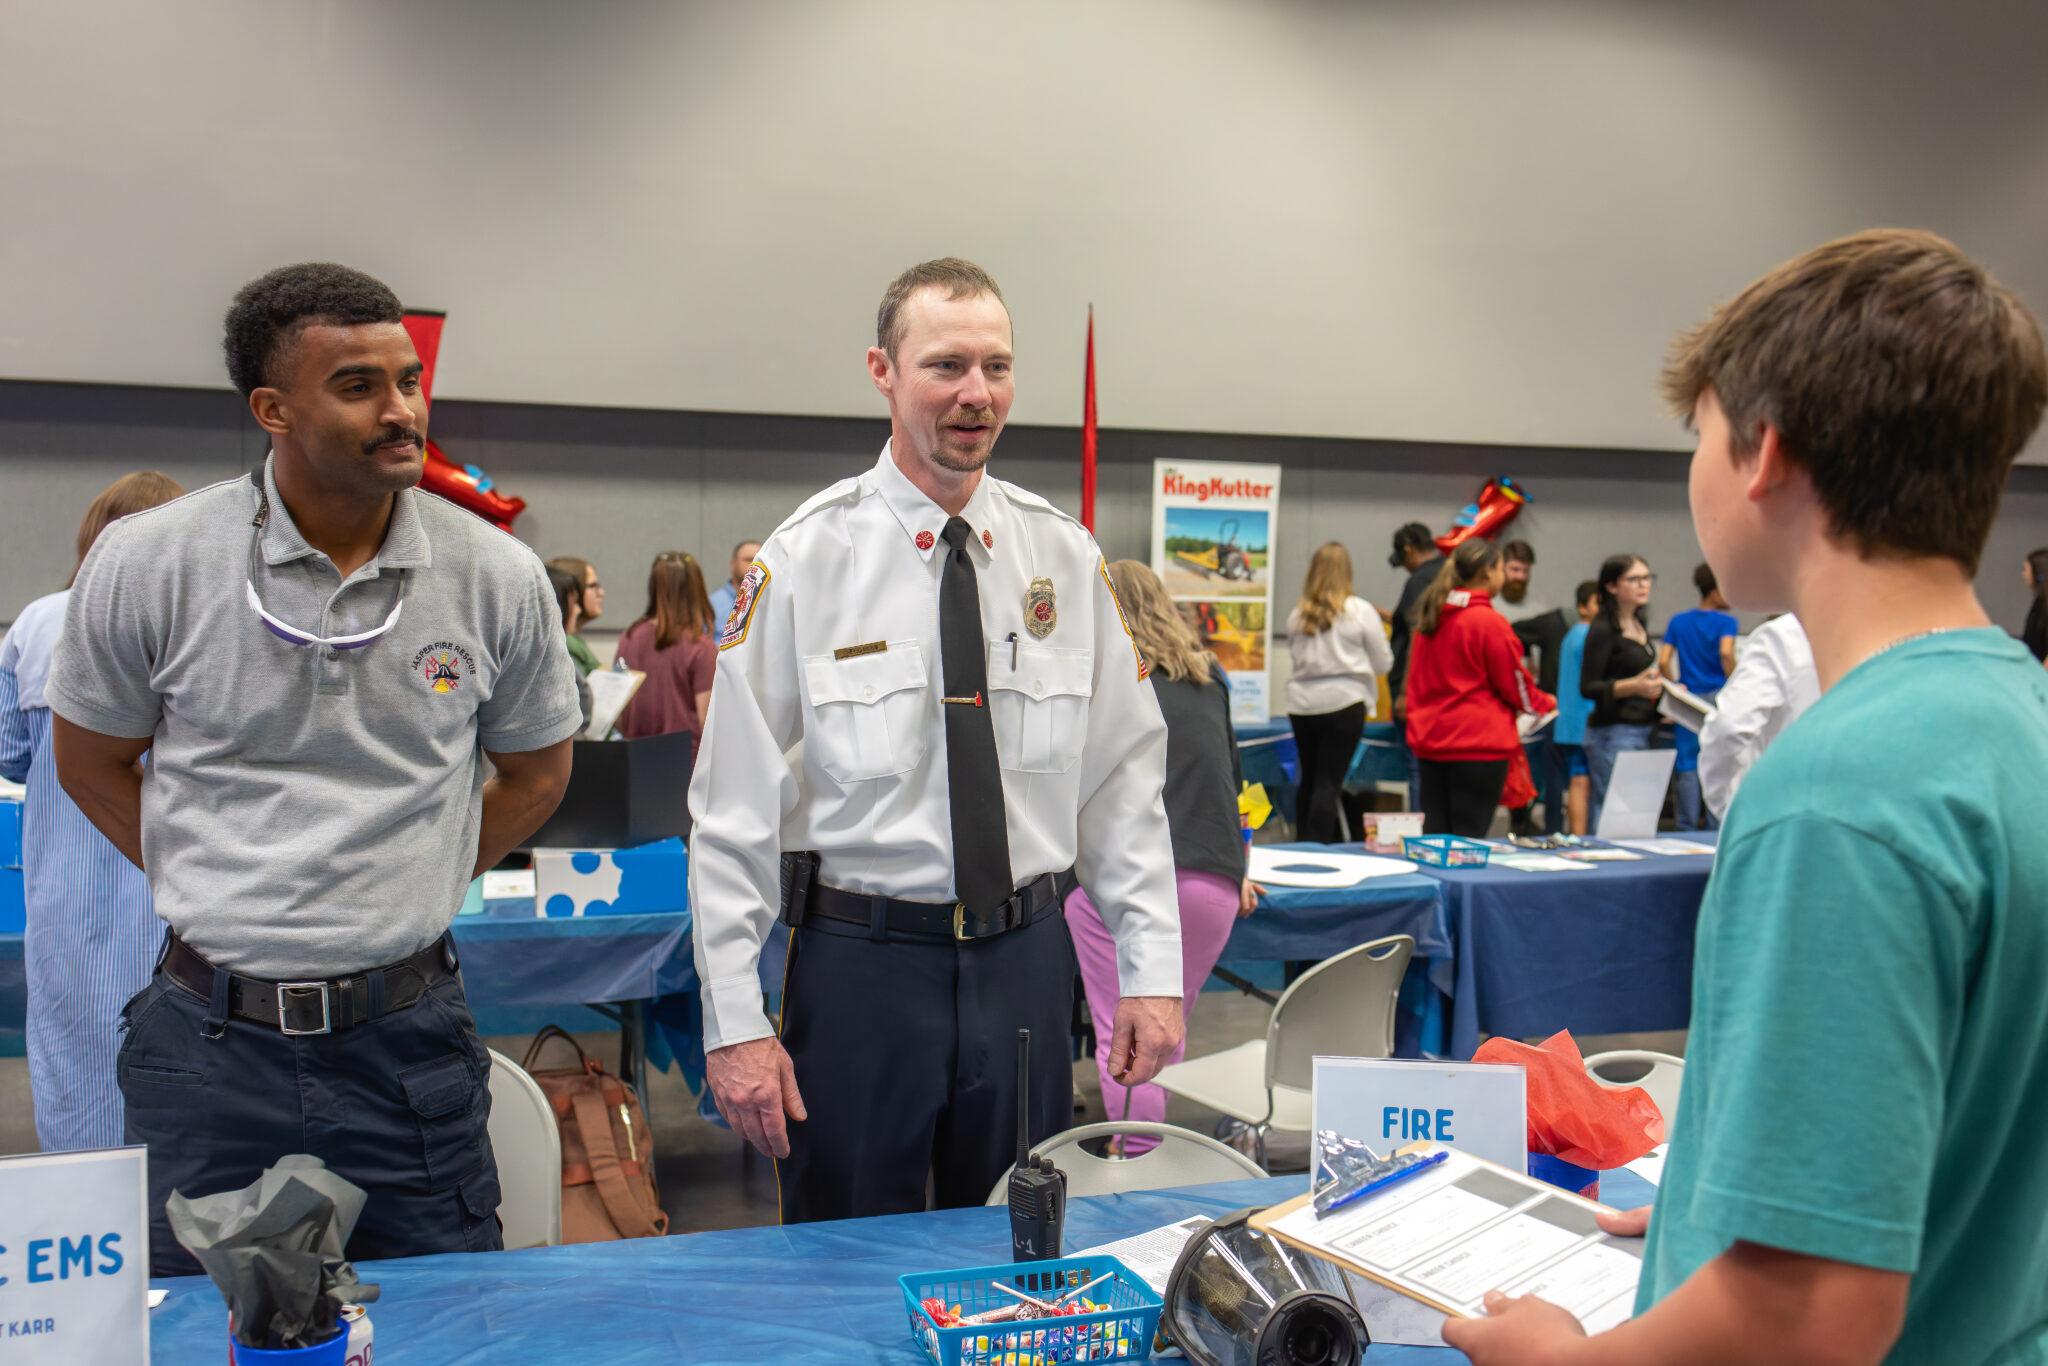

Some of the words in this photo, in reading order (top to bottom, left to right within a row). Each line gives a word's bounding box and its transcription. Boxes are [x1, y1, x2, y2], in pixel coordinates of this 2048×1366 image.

[1163, 475, 1273, 501] KingKutter
[412, 645, 433, 670] JASPER
[434, 641, 454, 650] FIRE
[454, 646, 476, 675] RESCUE
[1383, 1106, 1454, 1141] FIRE
[28, 1232, 124, 1283] EMS
[9, 1318, 55, 1337] KARR
